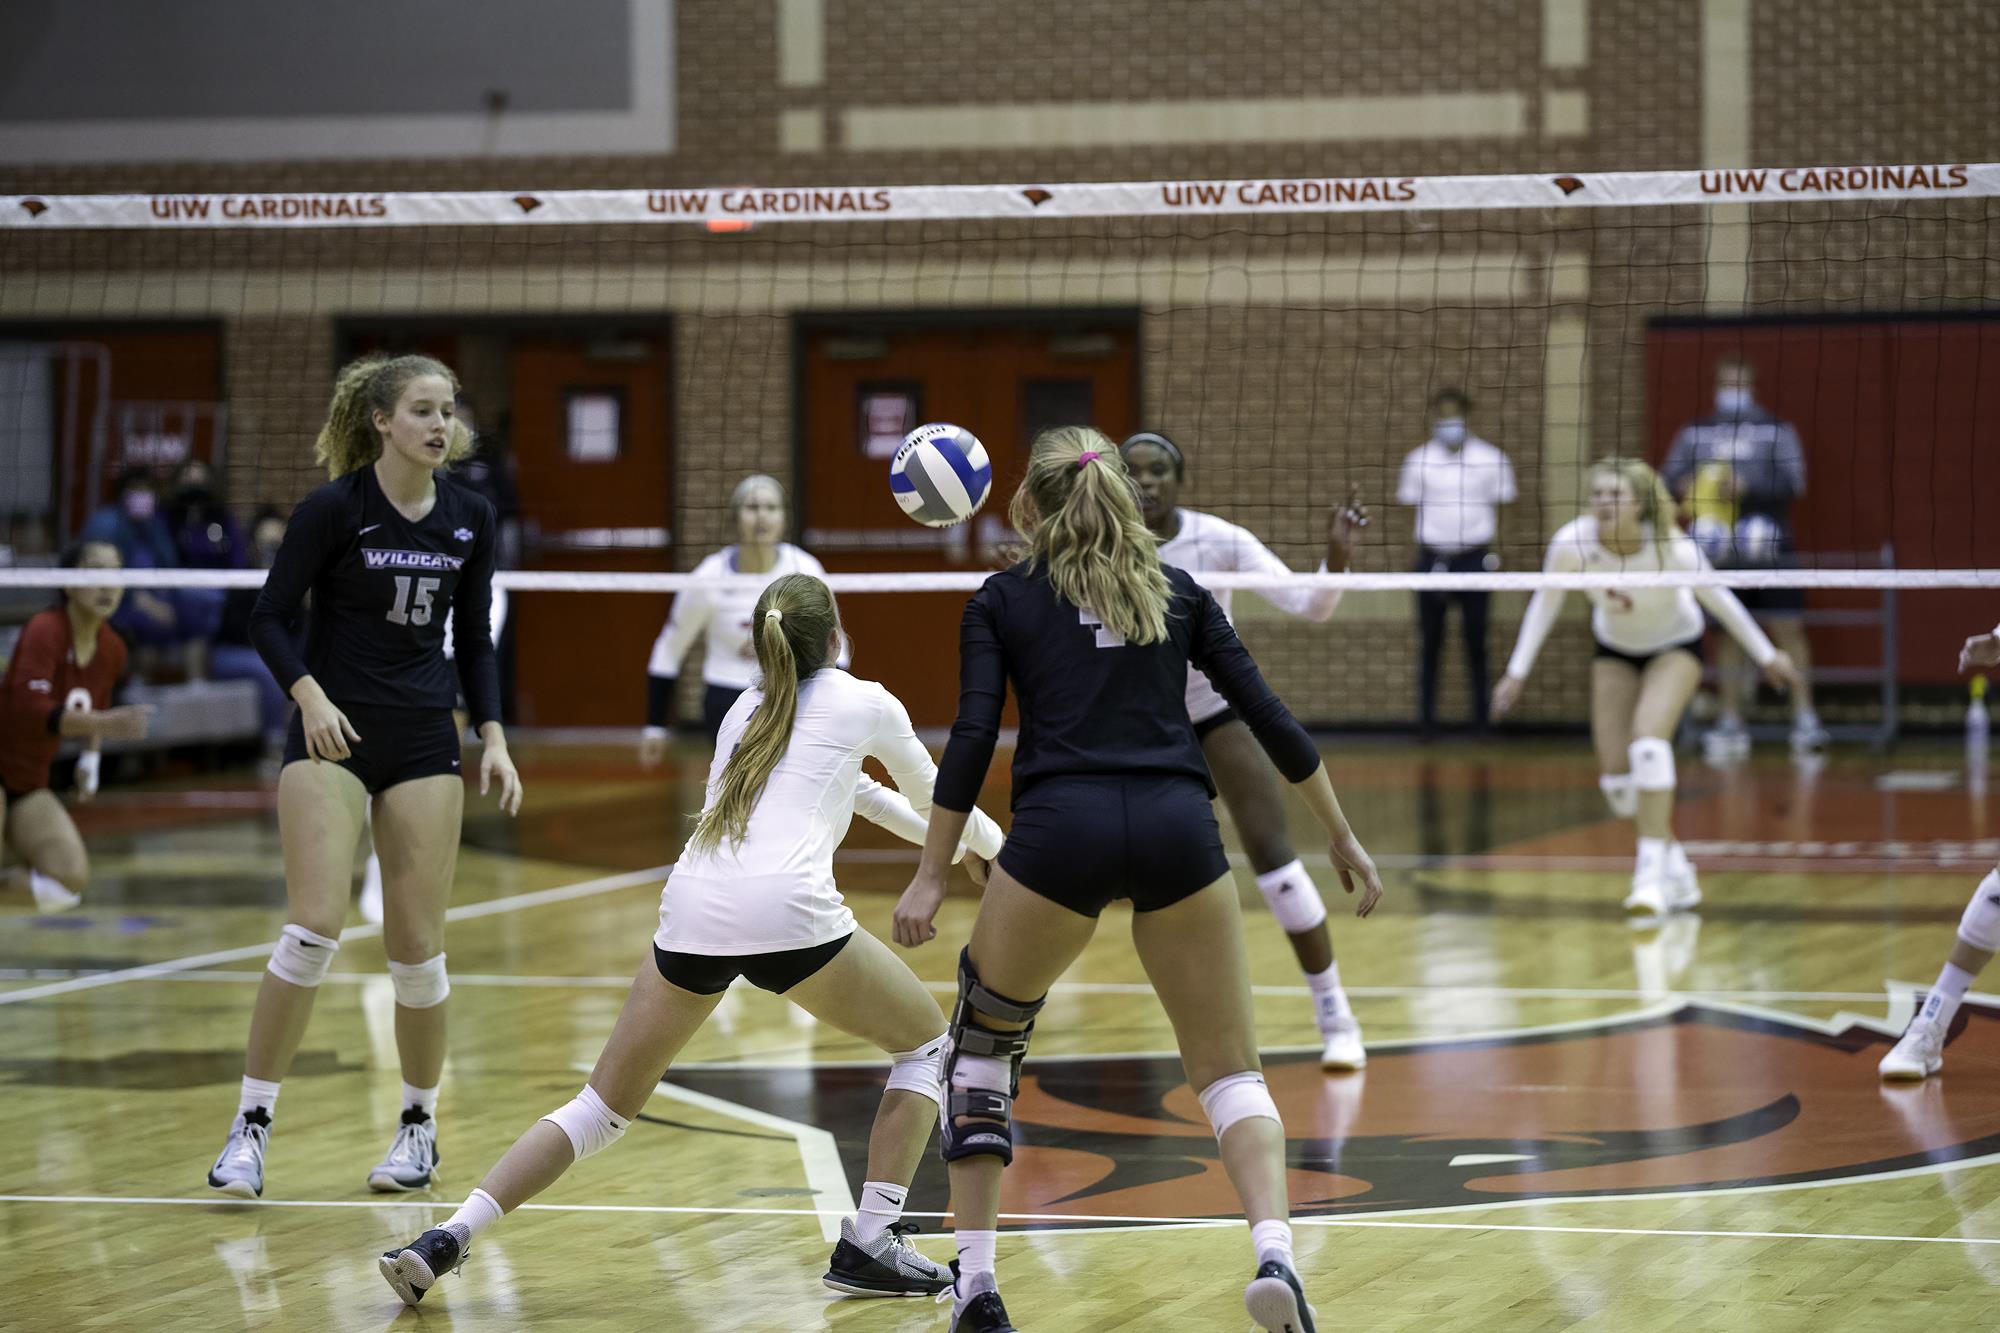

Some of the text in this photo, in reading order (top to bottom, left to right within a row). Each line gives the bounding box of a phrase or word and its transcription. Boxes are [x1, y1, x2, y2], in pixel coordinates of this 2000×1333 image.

[1162, 179, 1417, 206] UIW CARDINALS
[1700, 165, 1968, 193] UIW CARDINALS
[150, 197, 387, 219] UIW CARDINALS
[648, 191, 891, 213] UIW CARDINALS
[386, 575, 441, 626] 15
